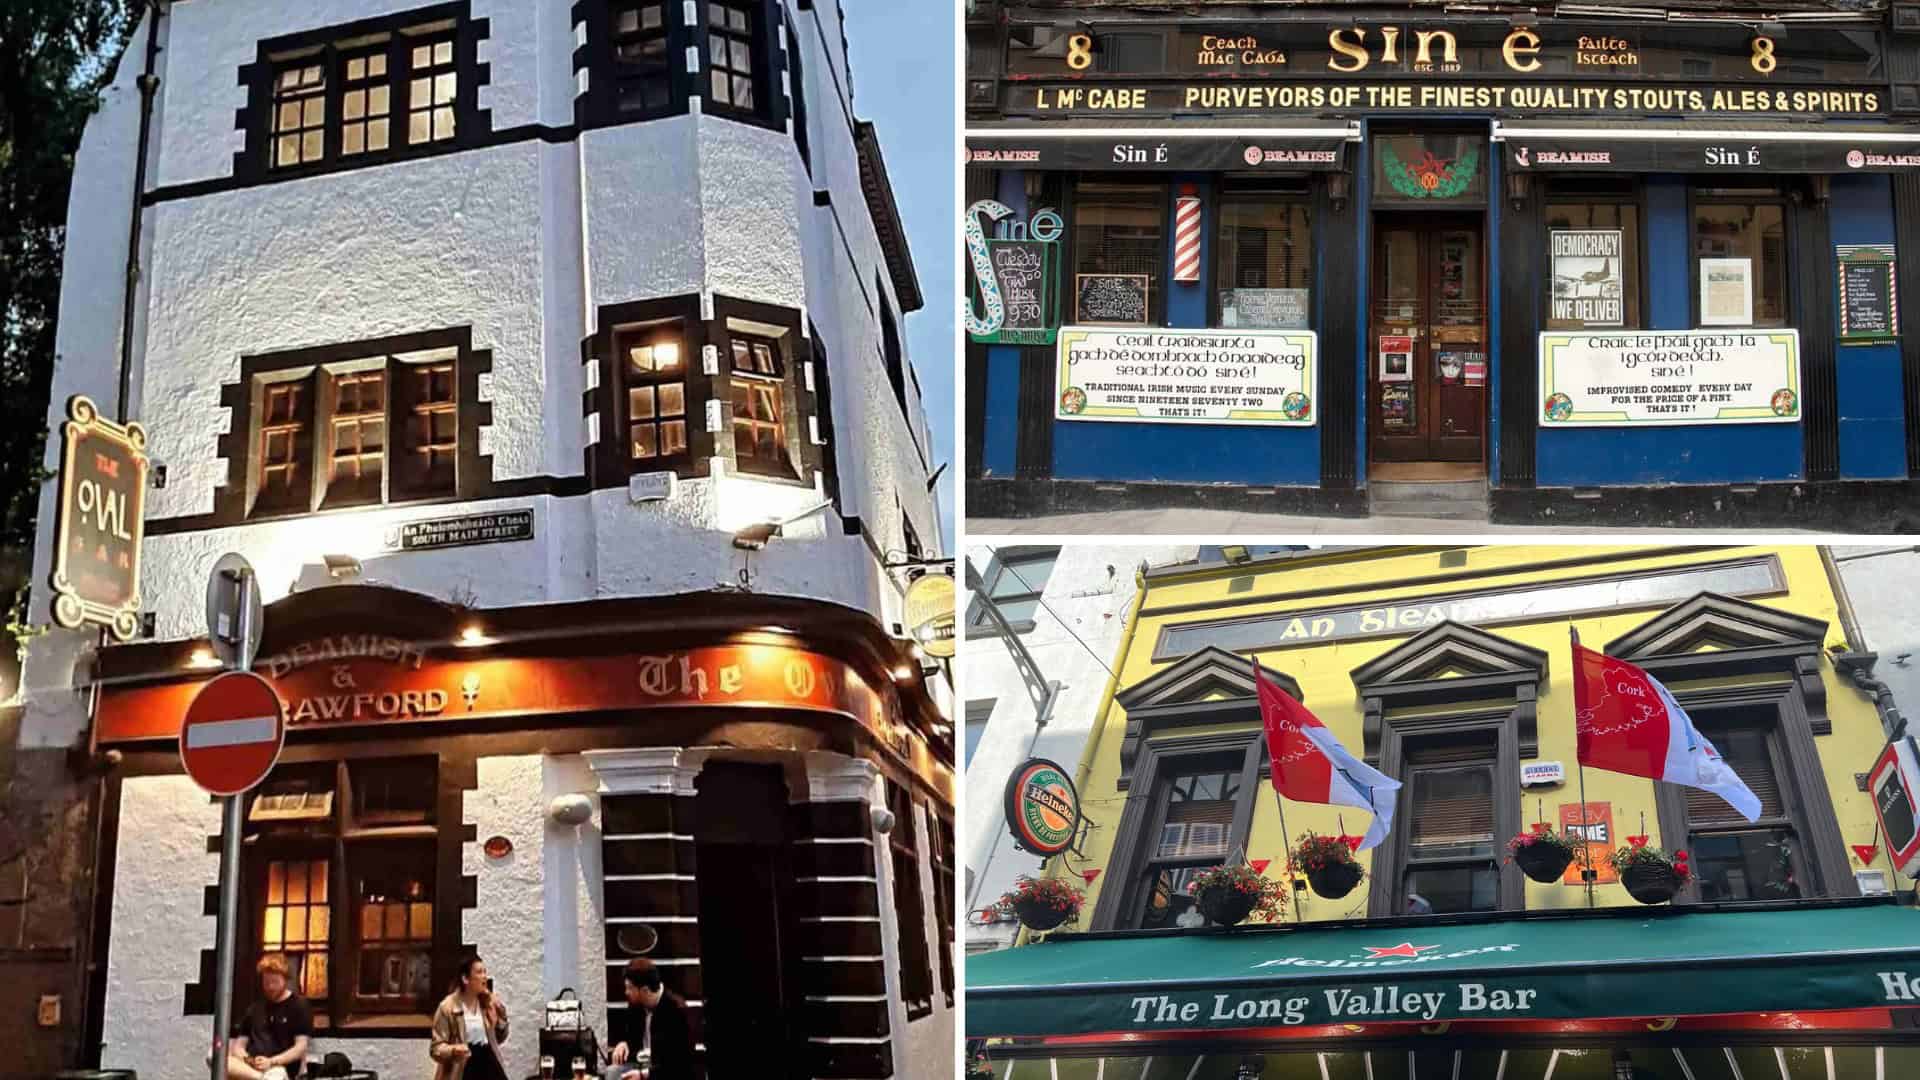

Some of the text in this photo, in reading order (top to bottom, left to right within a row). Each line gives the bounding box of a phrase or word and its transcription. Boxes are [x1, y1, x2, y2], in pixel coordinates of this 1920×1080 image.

[1067, 33, 1092, 71] 8
[1751, 36, 1777, 73] 8
[1037, 89, 1049, 110] L
[1185, 86, 1325, 108] PURVEYORS
[1329, 86, 1361, 107] OF
[1366, 86, 1412, 107] THE
[1421, 86, 1505, 107] FINEST
[1510, 87, 1608, 109] QUALITY
[1712, 90, 1770, 112] ALES
[1793, 91, 1878, 113] SPIRITS
[973, 149, 1041, 162] BEAMISH
[1112, 144, 1147, 163] Sin
[1263, 149, 1336, 162] BEAMISH
[1536, 151, 1611, 164] BEAMISH
[1704, 146, 1740, 165] Sin
[1554, 234, 1618, 256] DEMOCRACY
[1555, 300, 1619, 320] WE DELIVER
[1084, 382, 1285, 395] TRADITIONAL IRISH MUSIC EVERY SUNDAY
[1587, 383, 1752, 395] IMPROVISED COMEDY EVERY DAY
[1106, 395, 1263, 407] SINCE NINETEEN SEVENTY TWO
[1611, 395, 1631, 404] FOR
[1633, 395, 1653, 404] THE
[1655, 394, 1684, 403] PRICE
[1686, 394, 1698, 402] OF
[1700, 394, 1708, 402] A
[412, 526, 519, 545] SOUTH MAIN STREET
[271, 634, 425, 680] BEAMISH
[639, 654, 744, 700] The
[1617, 681, 1645, 698] Cork
[284, 688, 449, 723] RAWFORD
[1131, 983, 1537, 1025] The Long Valley Bar
